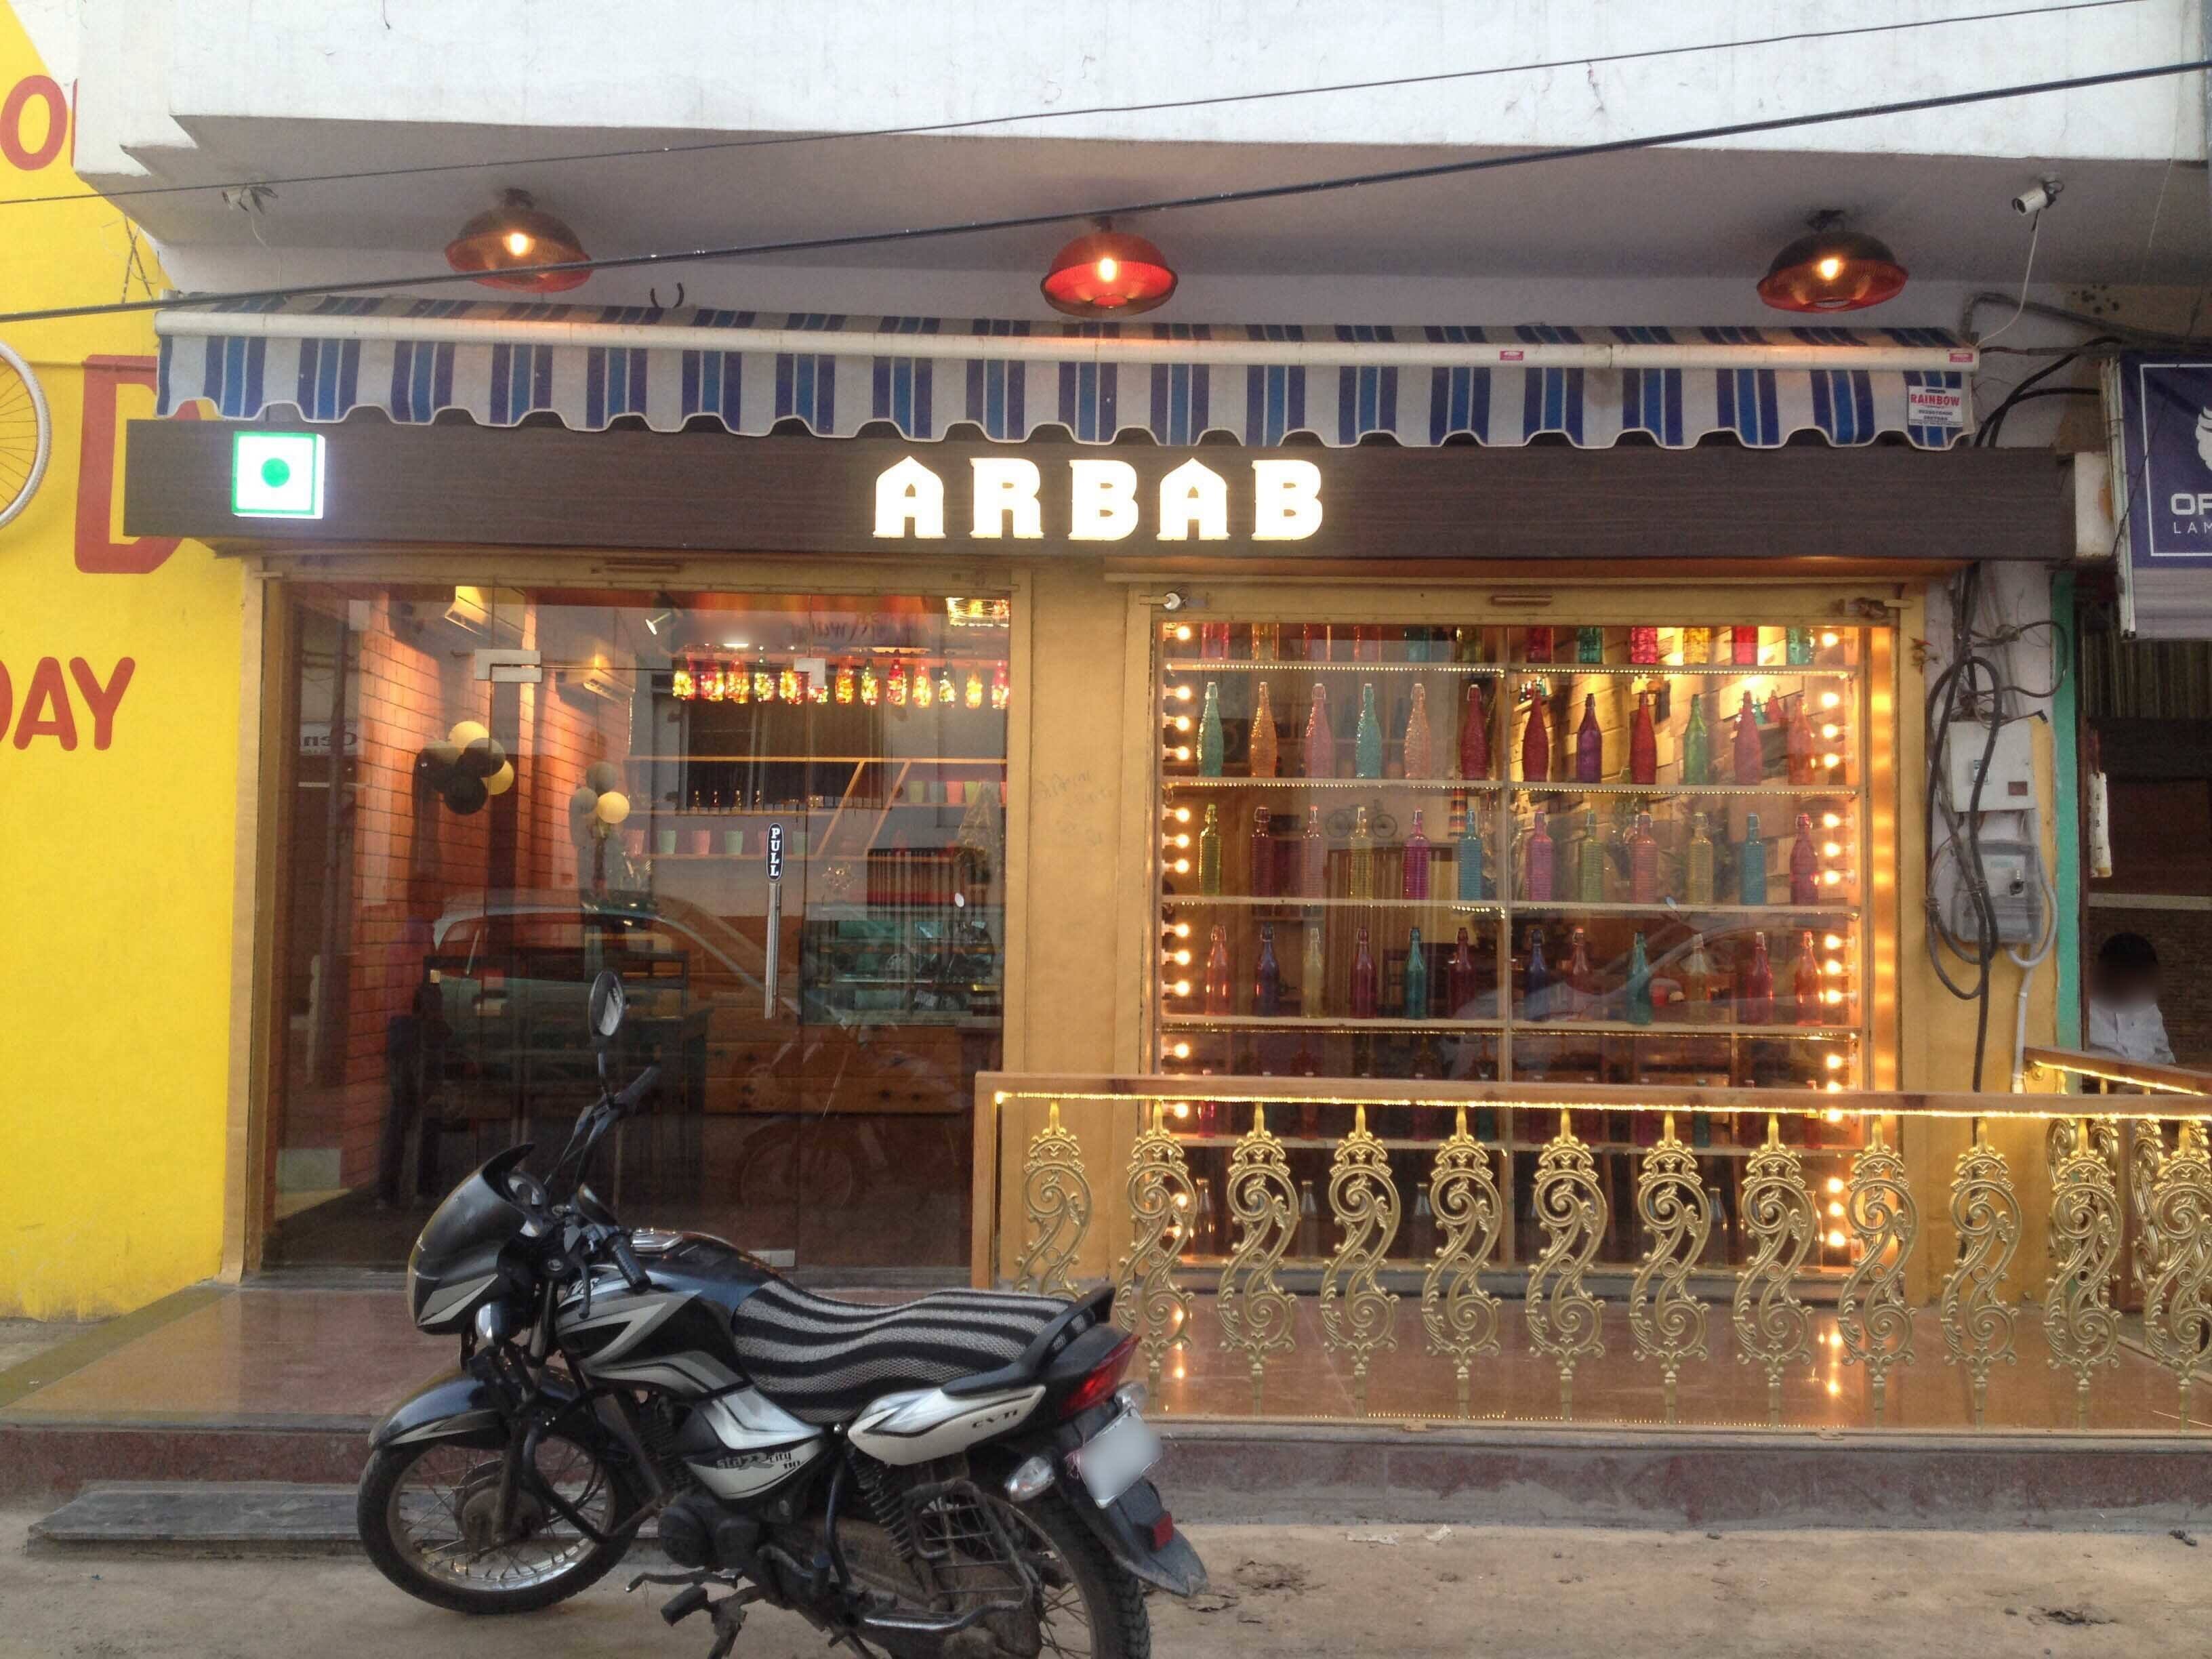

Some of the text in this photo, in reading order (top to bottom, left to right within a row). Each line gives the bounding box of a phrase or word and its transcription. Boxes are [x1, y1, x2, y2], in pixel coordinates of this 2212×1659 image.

[1910, 394, 1960, 407] RAINBOW
[872, 455, 1324, 541] ARBAB
[0, 656, 136, 752] AY
[769, 827, 781, 877] PULL
